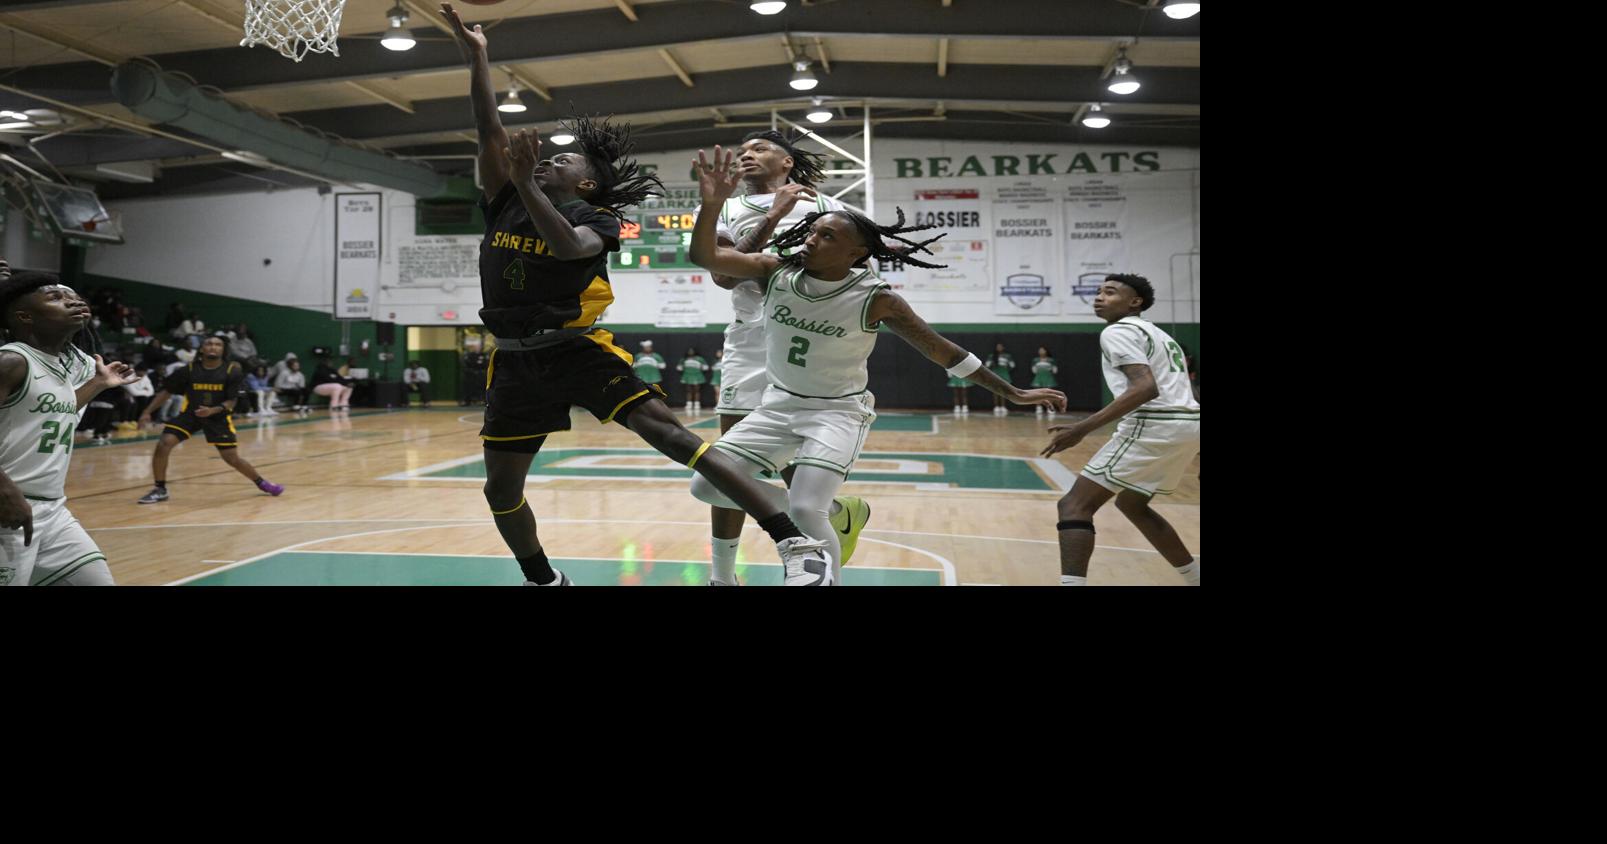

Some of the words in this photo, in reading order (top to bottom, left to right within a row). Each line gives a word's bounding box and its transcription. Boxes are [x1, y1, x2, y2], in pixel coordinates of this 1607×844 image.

[893, 152, 1160, 178] BEARKATS
[657, 214, 694, 231] 4:0
[915, 211, 980, 228] BOSSIER
[1000, 218, 1048, 228] BOSSIER
[1074, 221, 1117, 230] BOSSIER
[996, 228, 1053, 238] BEARKATS
[1070, 231, 1122, 241] BEARKATS
[503, 258, 526, 290] 4
[770, 304, 848, 338] Bossier
[787, 335, 810, 368] 2
[29, 392, 77, 415] Bossi
[37, 420, 74, 454] 24
